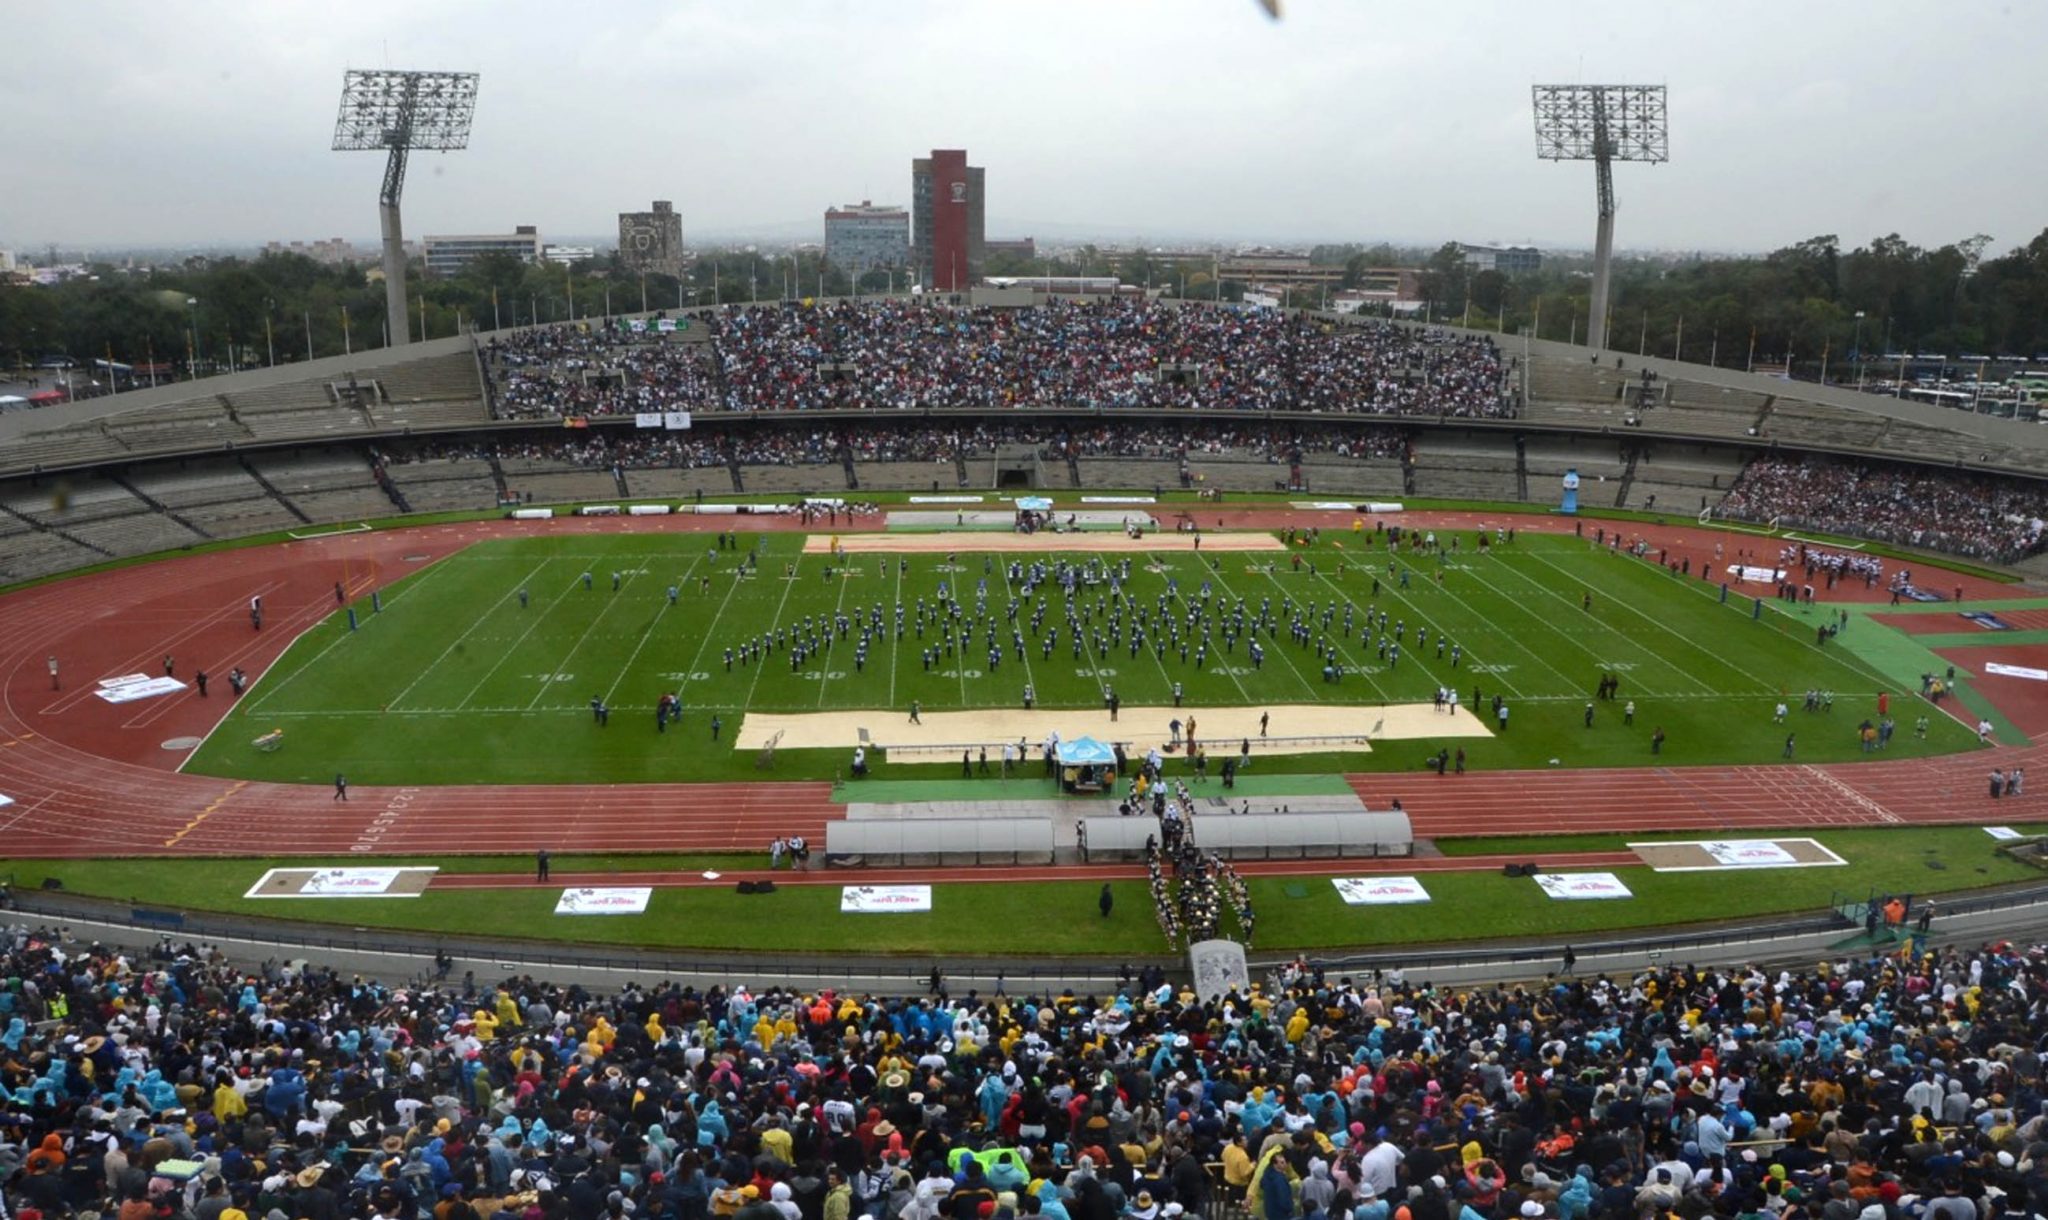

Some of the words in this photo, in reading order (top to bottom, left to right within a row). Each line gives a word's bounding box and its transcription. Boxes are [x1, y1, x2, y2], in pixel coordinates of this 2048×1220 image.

[804, 671, 846, 680] 30
[941, 670, 982, 679] 40
[1075, 668, 1117, 677] 50
